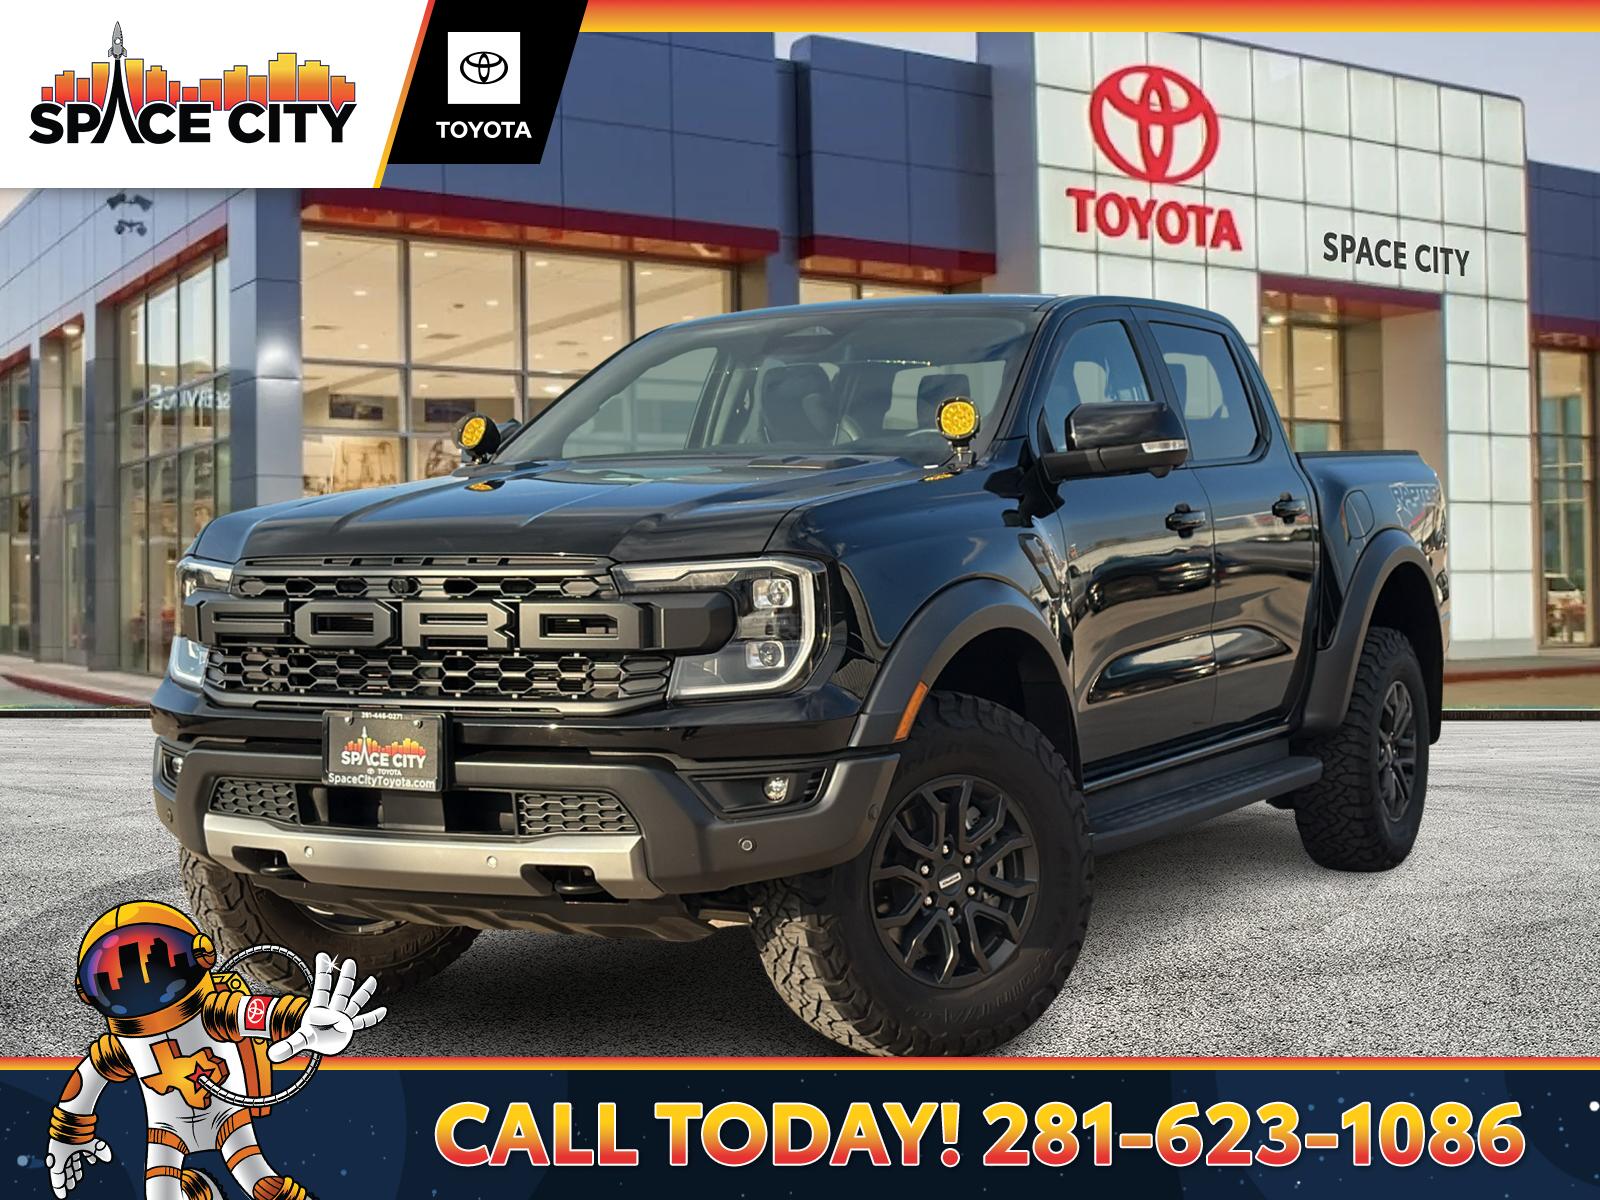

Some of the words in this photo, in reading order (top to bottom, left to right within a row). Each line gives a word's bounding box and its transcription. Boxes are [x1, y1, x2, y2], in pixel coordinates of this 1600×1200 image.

[1066, 188, 1242, 251] TOYOTA
[1323, 232, 1407, 270] SPACE
[1414, 244, 1470, 277] CITY
[199, 598, 643, 650] FORD
[341, 750, 389, 766] SPACE
[392, 753, 426, 769] CITY
[377, 768, 402, 776] TOYOTA
[328, 772, 435, 789] SpaceCityToyota.com
